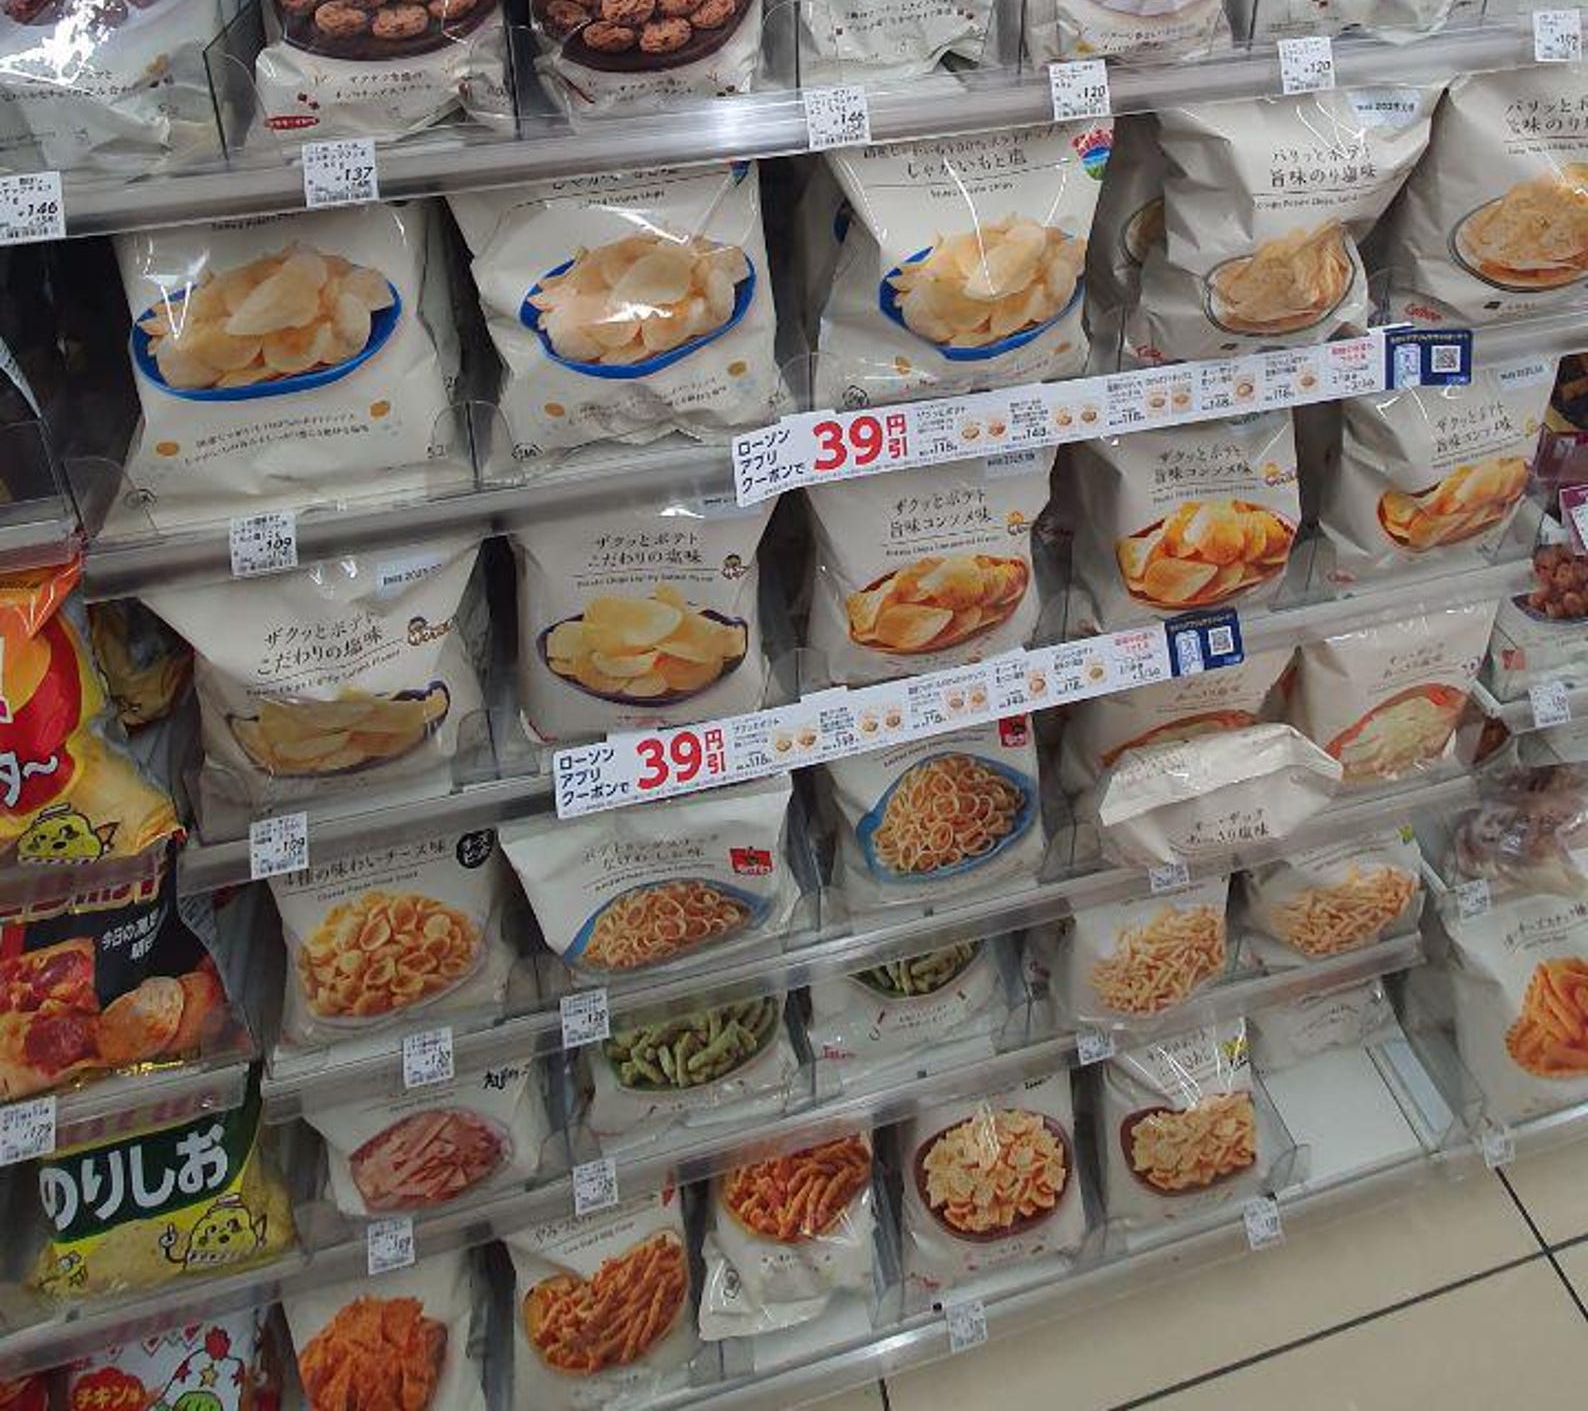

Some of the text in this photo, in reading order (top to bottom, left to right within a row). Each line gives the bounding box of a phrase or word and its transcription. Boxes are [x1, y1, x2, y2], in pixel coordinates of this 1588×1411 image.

[1082, 85, 1106, 100] 120
[343, 166, 373, 182] 137
[1269, 165, 1377, 188] 旨味のり塩味
[27, 201, 58, 218] 146
[738, 429, 790, 456] ローソン
[812, 416, 883, 471] 39
[740, 450, 777, 475] アプリ
[742, 462, 805, 494] クーポンで
[257, 625, 383, 675] こだわりの塩味
[559, 749, 615, 771] ローソン
[635, 731, 702, 791] 39
[560, 768, 601, 790] アプリ
[562, 782, 630, 808] クーポンで
[39, 1123, 229, 1232] のりしお
